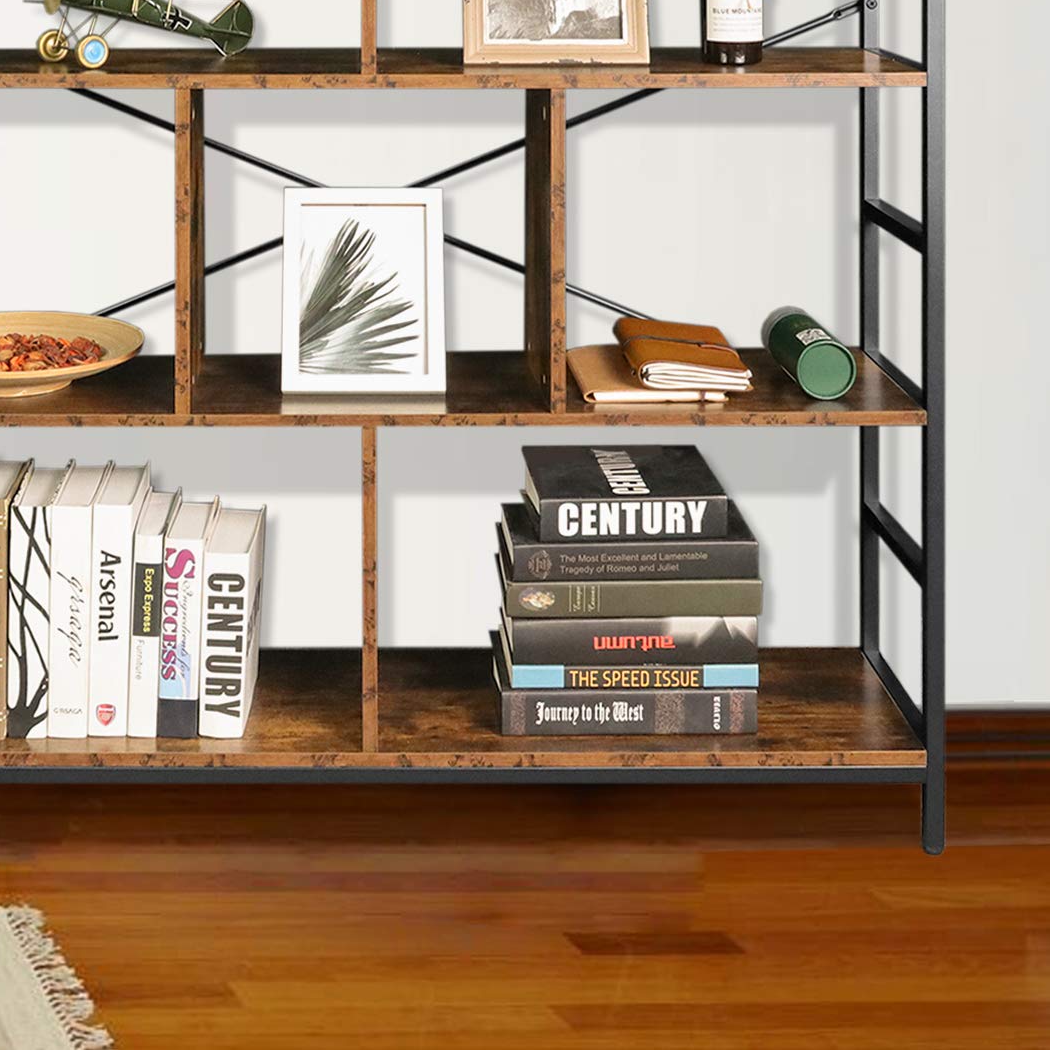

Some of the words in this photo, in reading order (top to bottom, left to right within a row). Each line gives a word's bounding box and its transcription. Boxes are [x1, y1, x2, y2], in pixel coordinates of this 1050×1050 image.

[590, 449, 650, 495] CENTURY
[557, 500, 708, 537] CENTURY
[560, 554, 576, 563] The
[578, 553, 599, 563] Most
[600, 553, 640, 562] Excellent
[641, 552, 657, 561] and
[659, 551, 708, 561] Lamentable
[560, 565, 594, 575] Tragedy
[595, 564, 605, 573] of
[606, 564, 637, 573] Romeo
[639, 563, 655, 572] and
[657, 563, 680, 572] Juliet
[97, 550, 122, 641] Arsenal
[143, 568, 155, 592] Expo
[142, 594, 154, 633] Express
[161, 547, 196, 680] SUCCESS
[135, 639, 145, 680] Furniture
[204, 573, 246, 718] CENTURY
[593, 635, 676, 652] autumn
[569, 670, 599, 687] THE
[602, 670, 650, 687] SPEED
[654, 670, 699, 687] ISSUE
[535, 701, 579, 725] Journey
[581, 703, 591, 722] to
[594, 702, 611, 725] the
[612, 701, 644, 725] West
